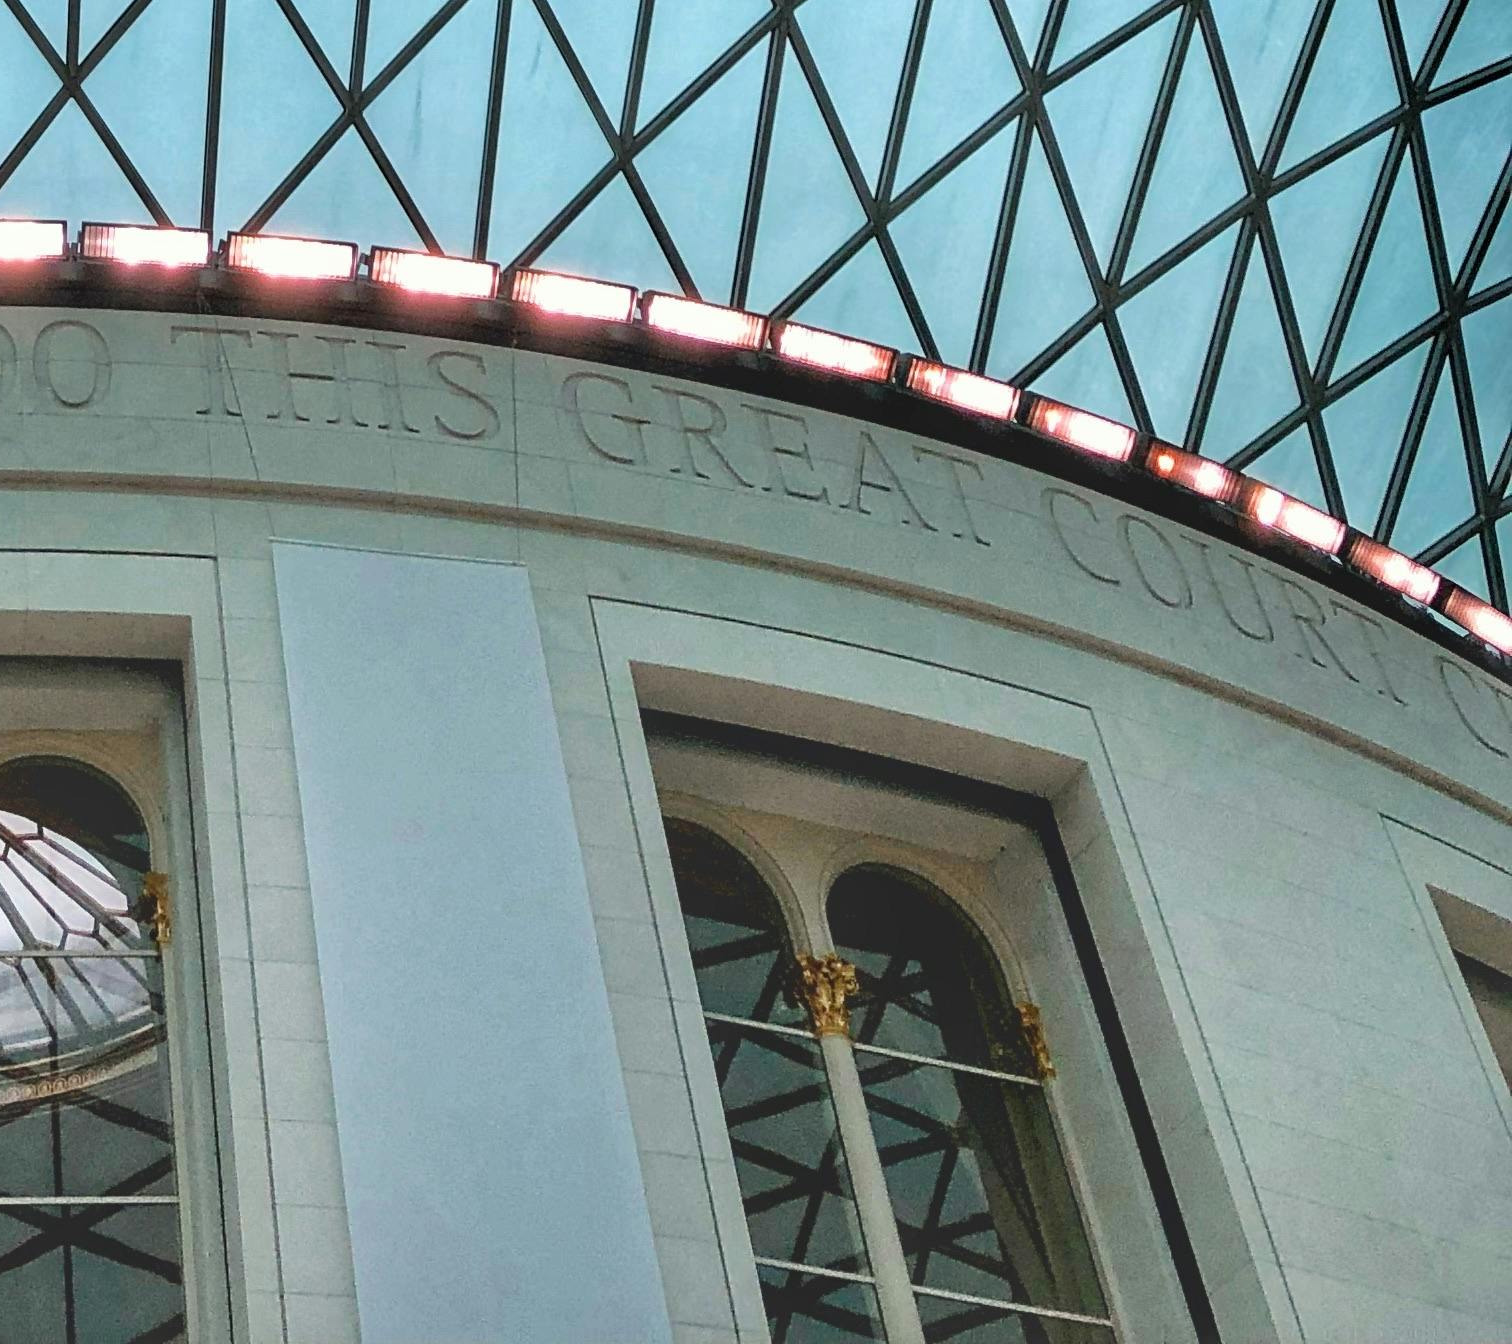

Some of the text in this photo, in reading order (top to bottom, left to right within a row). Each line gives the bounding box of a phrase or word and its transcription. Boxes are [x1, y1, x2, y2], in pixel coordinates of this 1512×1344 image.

[170, 324, 500, 440] THIS
[560, 371, 991, 547] GREAT
[1039, 486, 1409, 707] COURT
